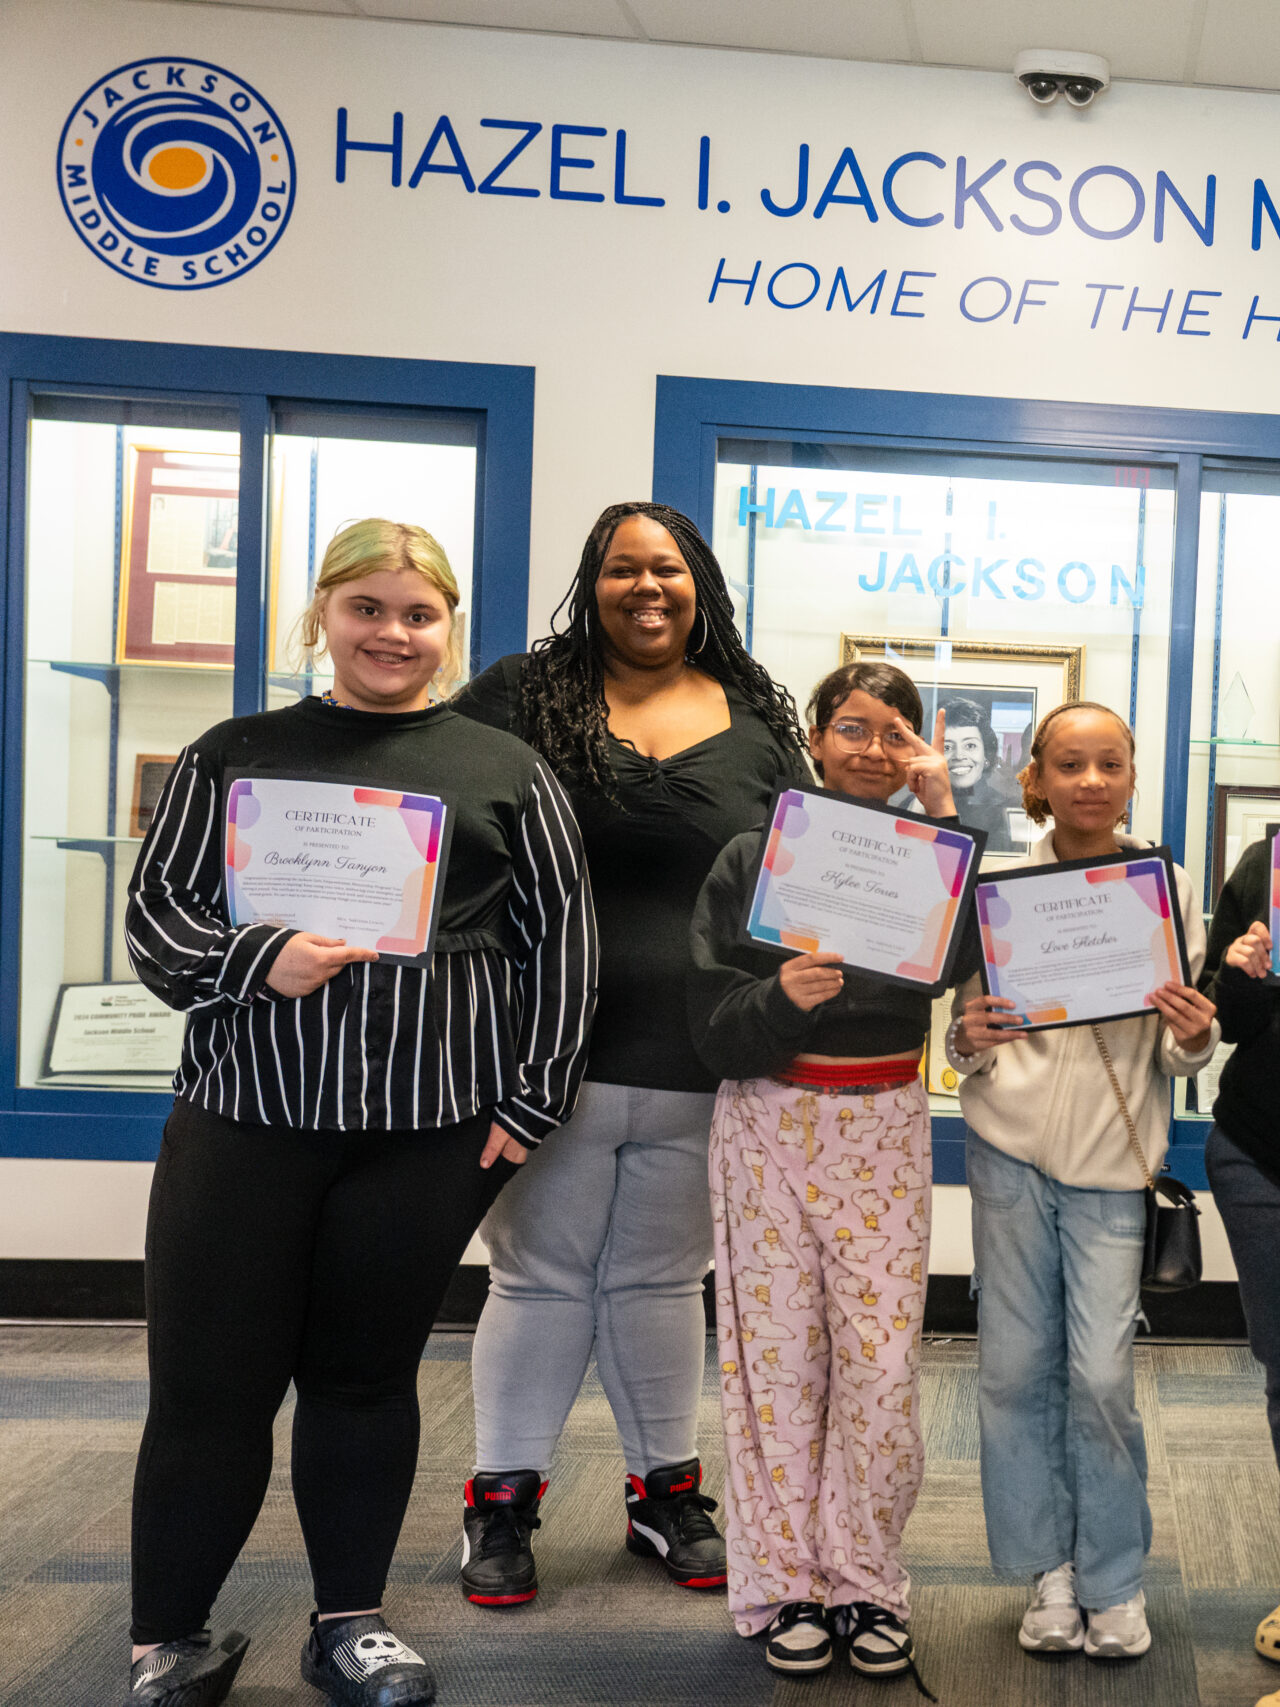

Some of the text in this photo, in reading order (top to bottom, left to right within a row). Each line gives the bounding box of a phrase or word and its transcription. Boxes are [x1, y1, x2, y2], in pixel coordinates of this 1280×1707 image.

[82, 65, 278, 145] JACKSON
[336, 108, 666, 207] HAZEL
[697, 136, 731, 214] I.
[760, 144, 1216, 247] JACKSON
[65, 163, 288, 281] MIDDLE SCHOOL
[708, 257, 937, 318] HOME
[959, 277, 1060, 325] OF
[1085, 283, 1223, 337] THE
[738, 486, 1007, 541] HAZEL I.
[858, 551, 1146, 607] JACKSON
[285, 809, 376, 828] CERTIFICATE
[306, 826, 363, 837] PARTICIPATION
[831, 830, 913, 859] CERTIFICATE
[849, 848, 899, 866] PARTICIPATION
[264, 850, 388, 877] Brooklynn Tanyon
[820, 870, 861, 890] Kylee
[1034, 893, 1113, 913] CERTIFICATE
[484, 1491, 511, 1501] PUMA
[670, 1482, 693, 1494] PUMA
